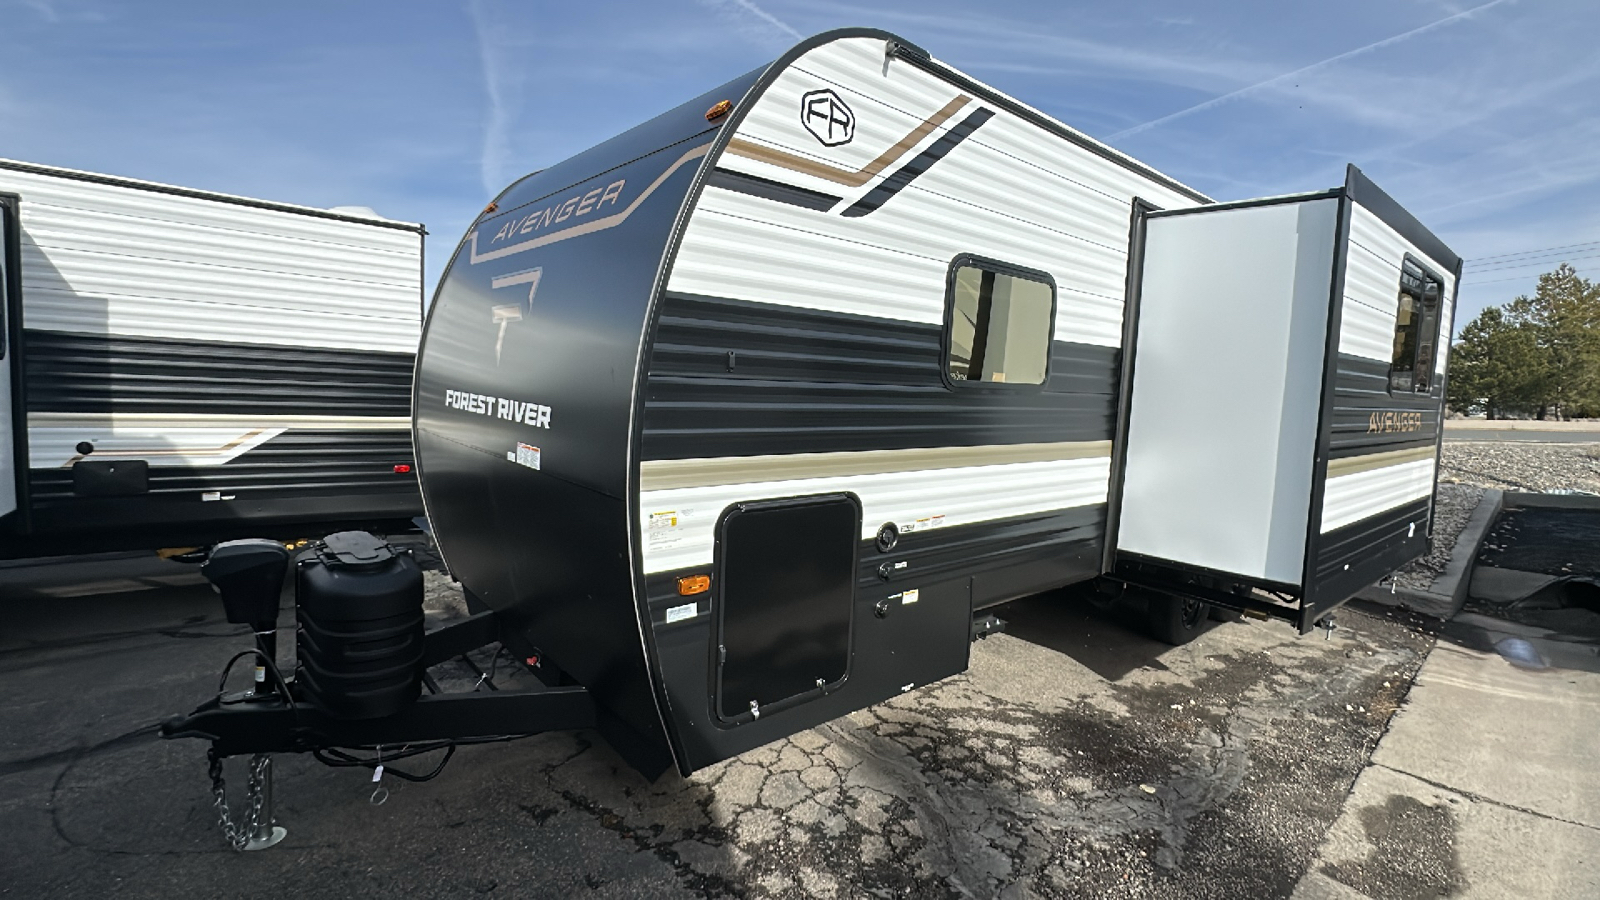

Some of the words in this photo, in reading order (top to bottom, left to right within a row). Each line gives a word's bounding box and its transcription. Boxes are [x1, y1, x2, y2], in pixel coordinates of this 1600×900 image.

[491, 179, 626, 244] AVENGER
[445, 389, 497, 416] FOREST
[497, 397, 552, 430] RIVER
[1367, 412, 1422, 434] AVENGER
